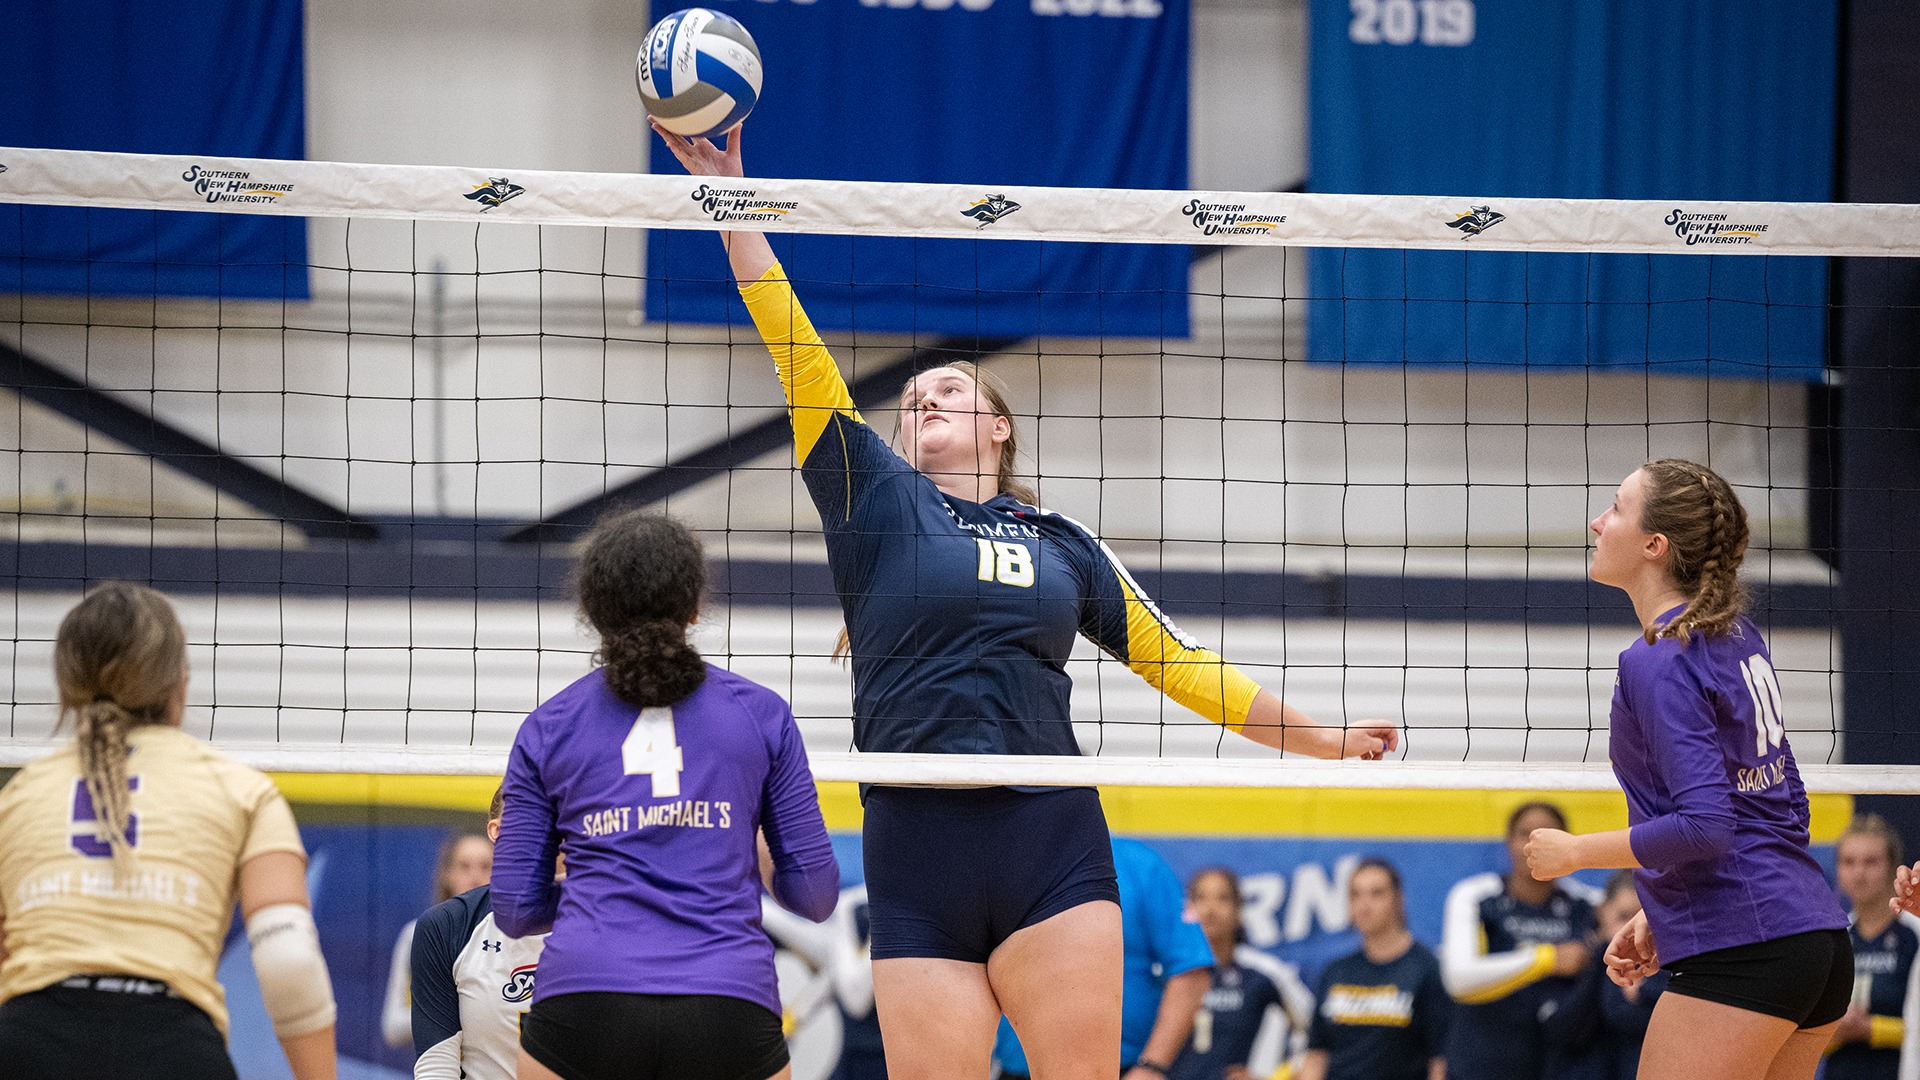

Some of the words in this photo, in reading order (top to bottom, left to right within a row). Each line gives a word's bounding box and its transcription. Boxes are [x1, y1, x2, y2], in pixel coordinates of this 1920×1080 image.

[1350, 0, 1476, 46] 2019
[182, 165, 250, 182] SOUTHERN
[195, 178, 226, 196] NEW
[226, 181, 294, 193] HAMPSHIRE
[691, 184, 756, 201] SOUTHERN
[206, 192, 275, 204] UNIVERSITY
[702, 197, 733, 214] NEW
[733, 199, 798, 211] HAMPSHIRE
[713, 210, 780, 222] UNIVERSITY
[1182, 199, 1246, 216] SOUTHERN
[1193, 211, 1223, 229] NEW
[1223, 214, 1286, 225] HAMPSHIRE
[1664, 209, 1728, 225] SOUTHERN
[1203, 224, 1269, 236] UNIVERSITY
[1675, 221, 1705, 238] NEW
[1704, 223, 1768, 234] HAMPSHIRE
[1686, 234, 1751, 246] UNIVERSITY
[972, 537, 1035, 589] 18
[1740, 653, 1785, 758] 10
[621, 706, 684, 798] 4
[582, 807, 631, 837] SAINT
[637, 800, 731, 829] MICHAEL'S
